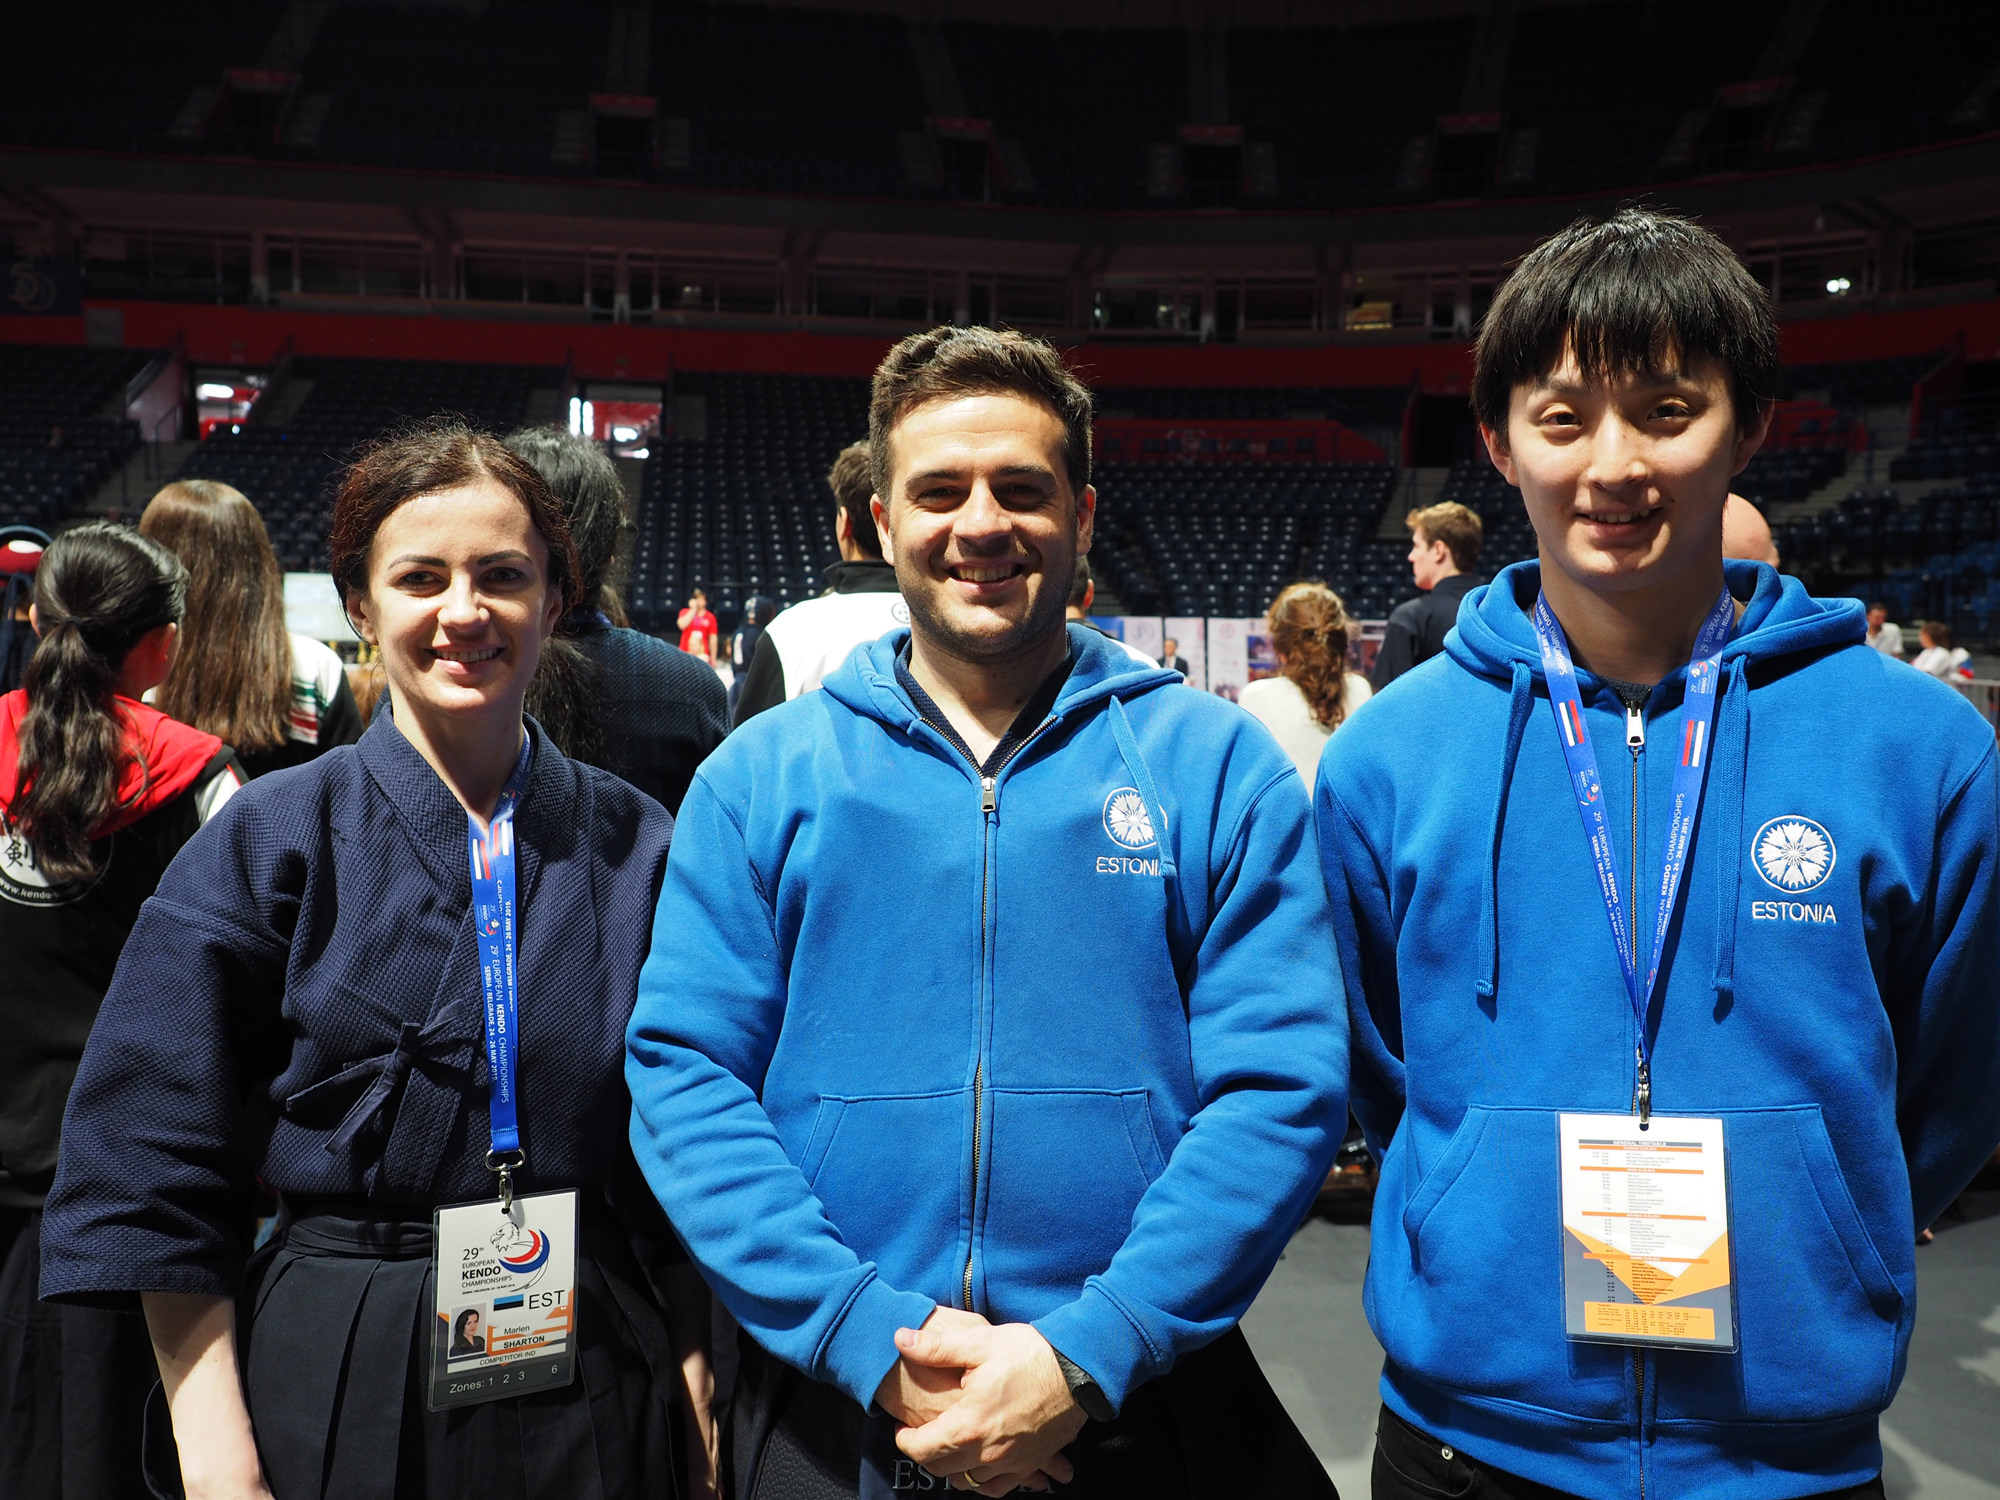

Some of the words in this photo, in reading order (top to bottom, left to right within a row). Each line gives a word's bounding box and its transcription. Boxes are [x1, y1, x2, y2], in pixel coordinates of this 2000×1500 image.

[1703, 612, 1722, 642] EUROPEAN
[1666, 793, 1685, 860] CHAMPIONSHIPS
[1676, 835, 1685, 850] MAY
[1096, 856, 1161, 876] ESTONI
[1591, 835, 1601, 858] SERBIA
[1611, 921, 1619, 935] MAY
[1662, 864, 1671, 895] KENDO
[1597, 826, 1612, 870] EUROPEAN
[1607, 872, 1618, 904] KENDO
[1615, 907, 1632, 976] CHAMPIONSHIPS
[1752, 901, 1837, 924] ESTONIA
[1655, 899, 1666, 944] EUROPEAN
[492, 959, 505, 999] EUROPEAN
[496, 1004, 506, 1034] KENDO
[498, 1037, 510, 1103] CHAMPIONSHIPS
[462, 1259, 495, 1269] EUROPEAN
[462, 1265, 501, 1280] KENDO
[462, 1275, 512, 1288] CHAMPIONSHIPS
[529, 1290, 565, 1310] EST
[503, 1336, 545, 1349] SHARTON
[504, 1325, 530, 1335] Marlen
[480, 1352, 523, 1366] COMPETITOR
[449, 1380, 485, 1394] Zones:
[488, 1377, 493, 1386] 1
[503, 1374, 510, 1384] 2
[518, 1371, 525, 1380] 3
[551, 1365, 558, 1374] 6
